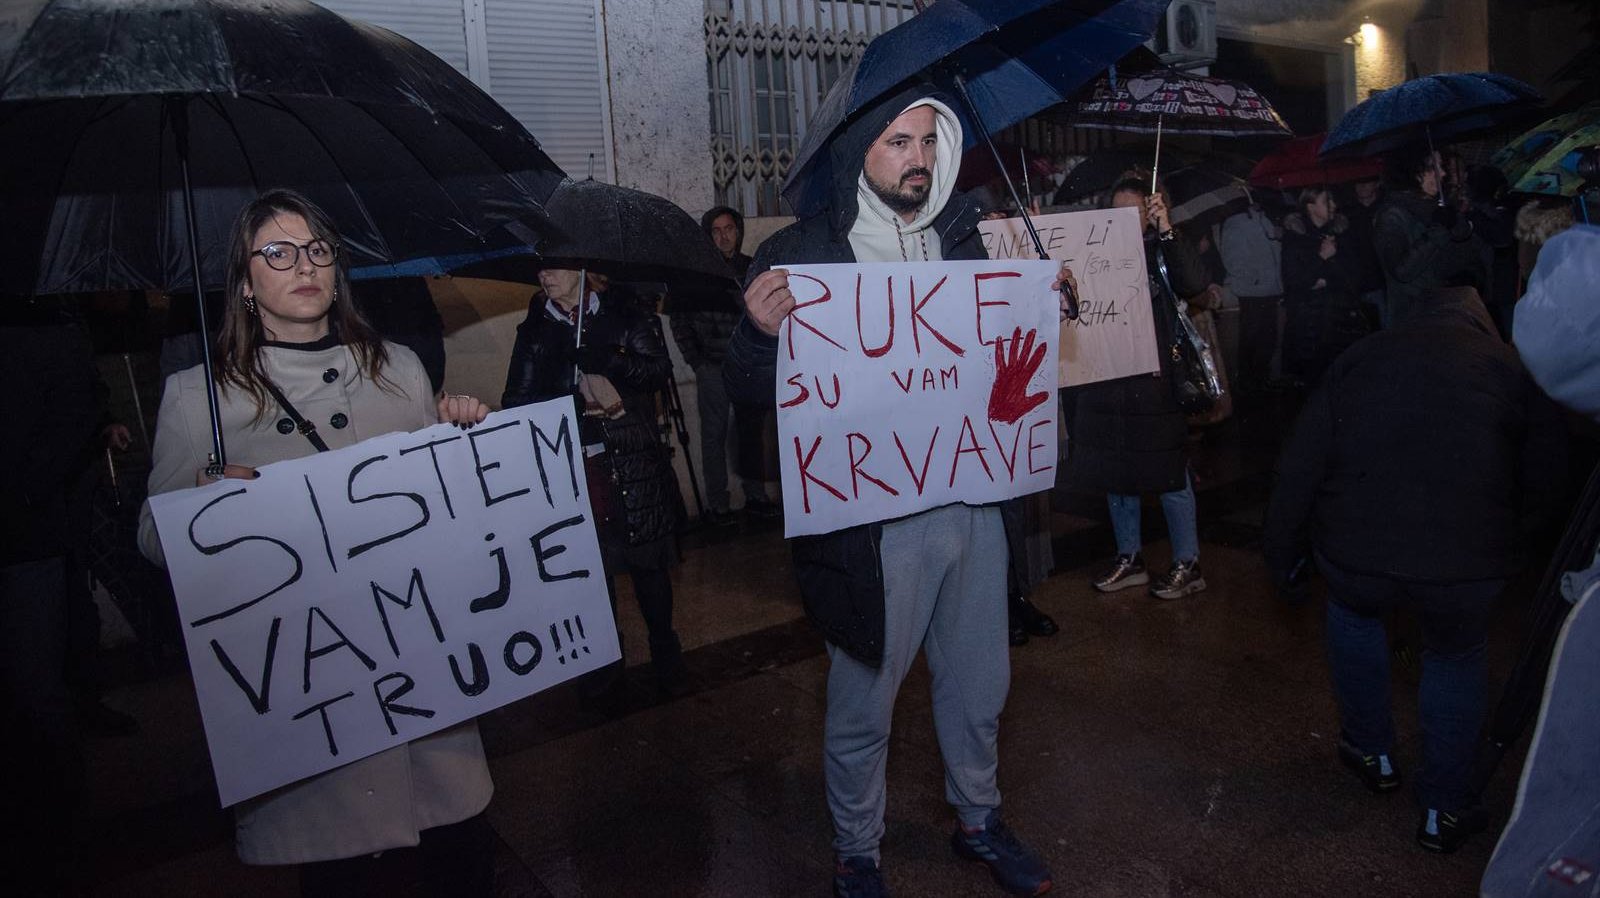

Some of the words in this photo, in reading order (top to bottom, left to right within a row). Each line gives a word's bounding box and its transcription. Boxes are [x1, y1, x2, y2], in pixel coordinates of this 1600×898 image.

[787, 271, 1024, 360] RUKE
[779, 372, 841, 409] SU
[891, 365, 958, 394] VAM
[190, 414, 580, 628] SISTEM
[793, 415, 1053, 514] KRVAVE
[210, 567, 446, 715] VAM
[292, 615, 591, 756] TRUO!!!
